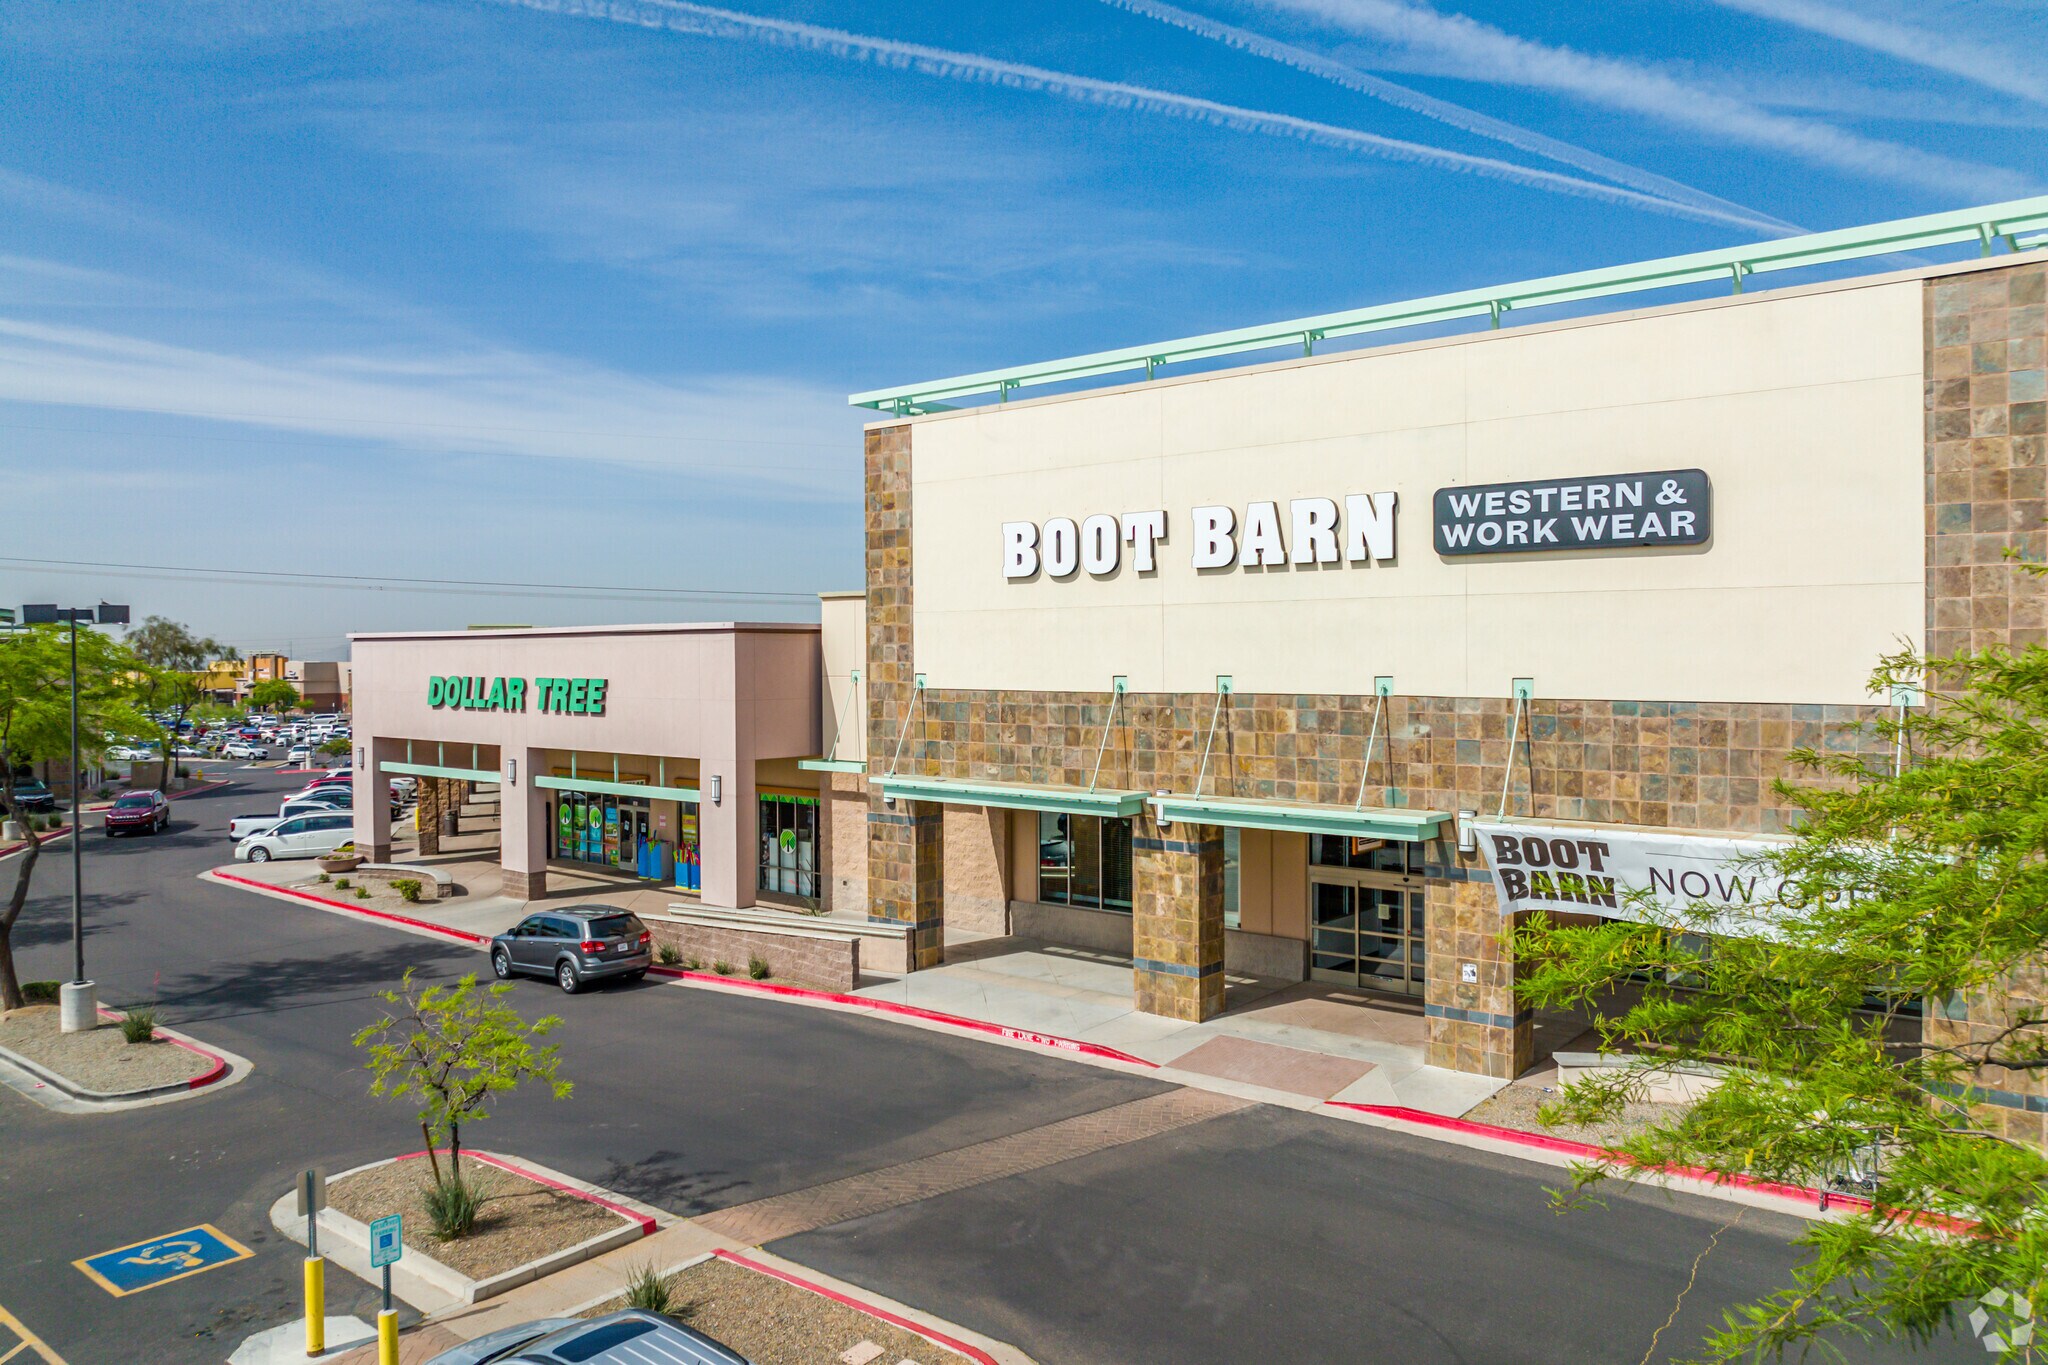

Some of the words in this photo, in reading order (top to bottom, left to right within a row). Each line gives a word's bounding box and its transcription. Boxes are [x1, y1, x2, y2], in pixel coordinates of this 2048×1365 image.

[1448, 482, 1643, 518] WESTERN
[1655, 480, 1688, 506] &
[1001, 510, 1168, 578] BOOT
[1191, 491, 1400, 568] BARN
[1441, 518, 1559, 548] WORK
[1570, 510, 1697, 541] WEAR
[427, 676, 526, 709] DOLLAR
[535, 678, 606, 713] TREE
[1491, 835, 1611, 873] BOOT
[1499, 868, 1618, 908] BARN
[1649, 867, 1757, 904] NOW
[1042, 1037, 1051, 1045] NO
[1054, 1040, 1080, 1052] PARKING
